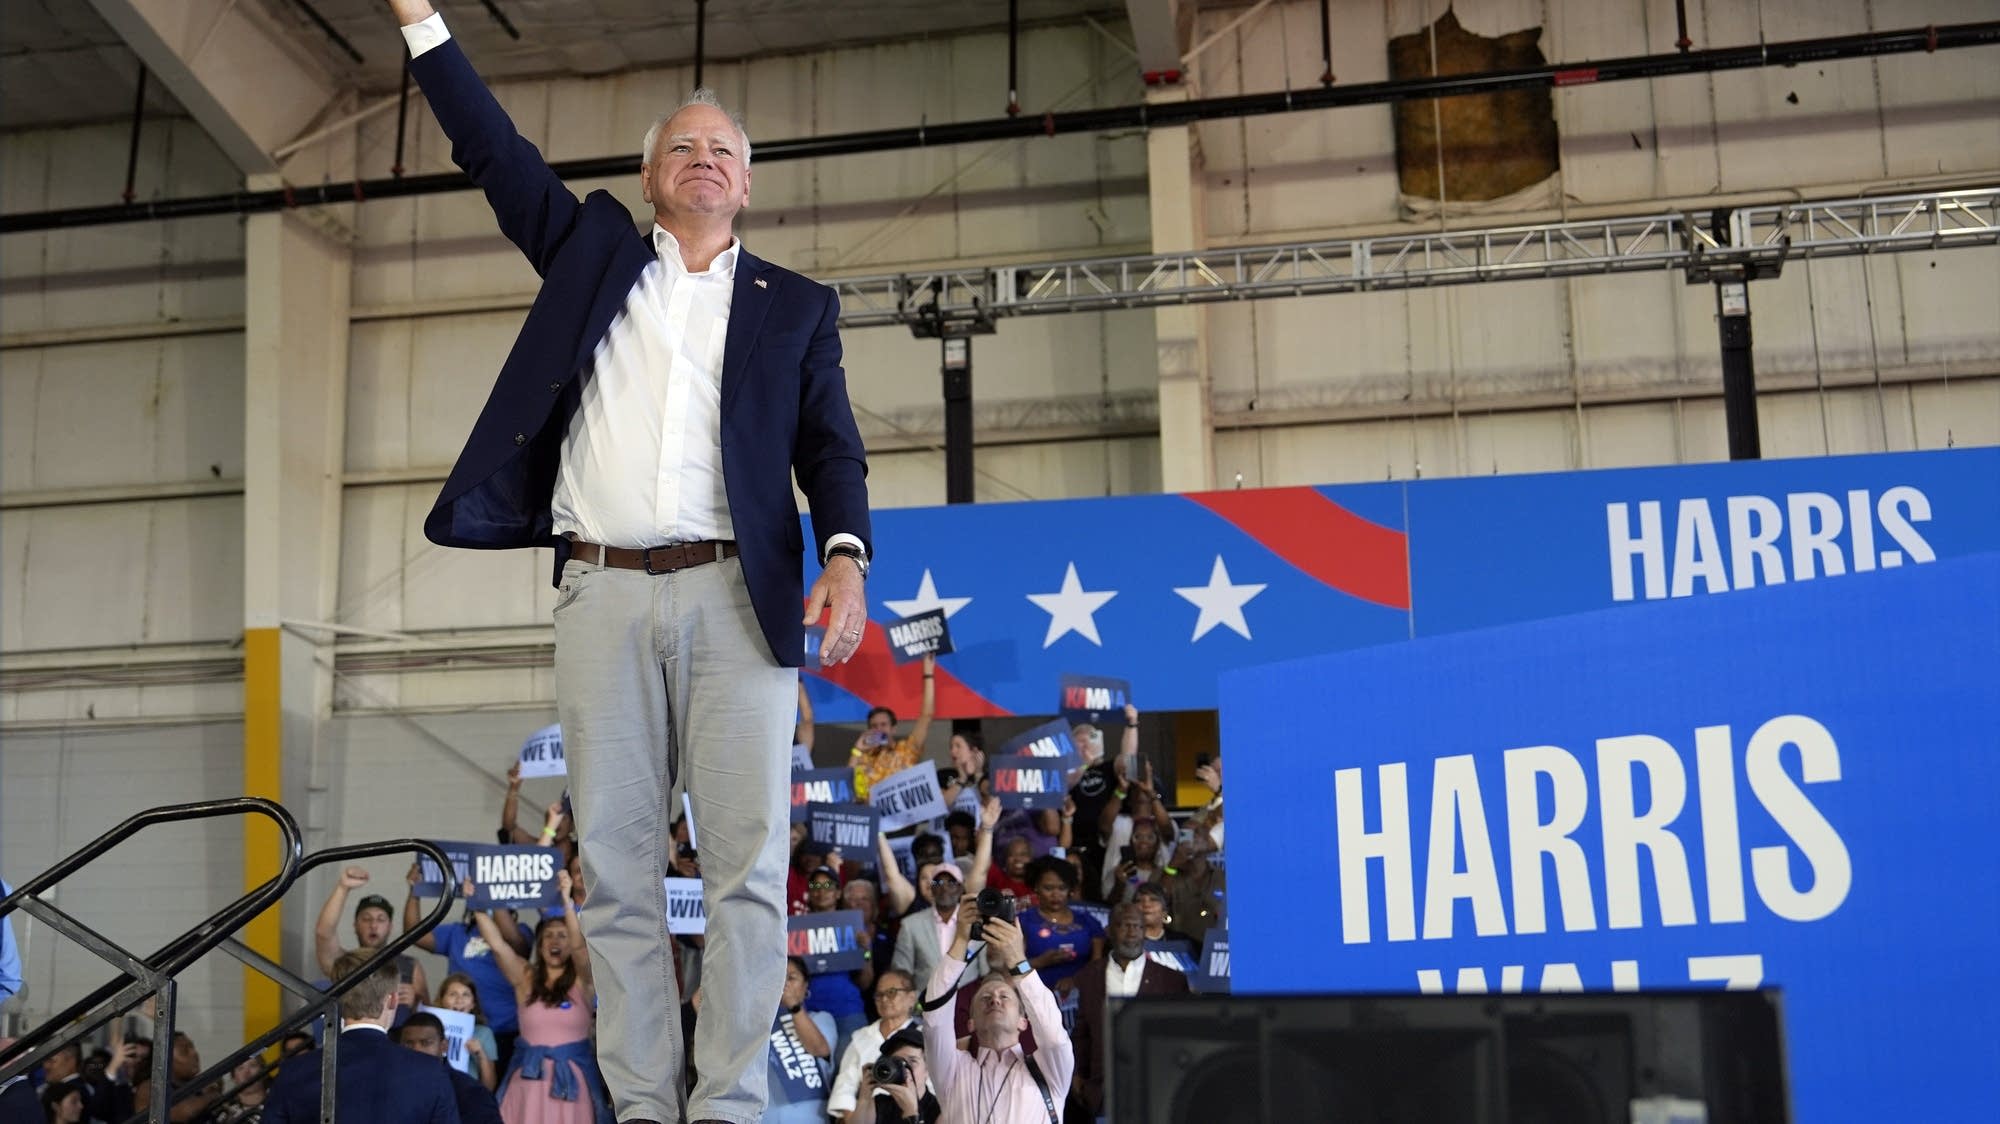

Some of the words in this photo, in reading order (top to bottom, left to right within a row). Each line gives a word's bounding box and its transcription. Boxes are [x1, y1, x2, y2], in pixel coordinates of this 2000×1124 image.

[1606, 486, 1937, 601] HARRIS
[889, 616, 943, 648] HARRIS
[904, 637, 939, 656] WALZ
[1065, 687, 1126, 711] KAMALA
[522, 742, 547, 762] WE
[995, 768, 1061, 794] KAMALA
[901, 782, 934, 811] WIN
[812, 821, 834, 843] WE
[835, 822, 870, 848] WIN
[1335, 714, 1852, 944] HARRIS
[476, 854, 554, 883] HARRIS
[489, 883, 542, 900] WALZ
[771, 1030, 802, 1080] WALZ
